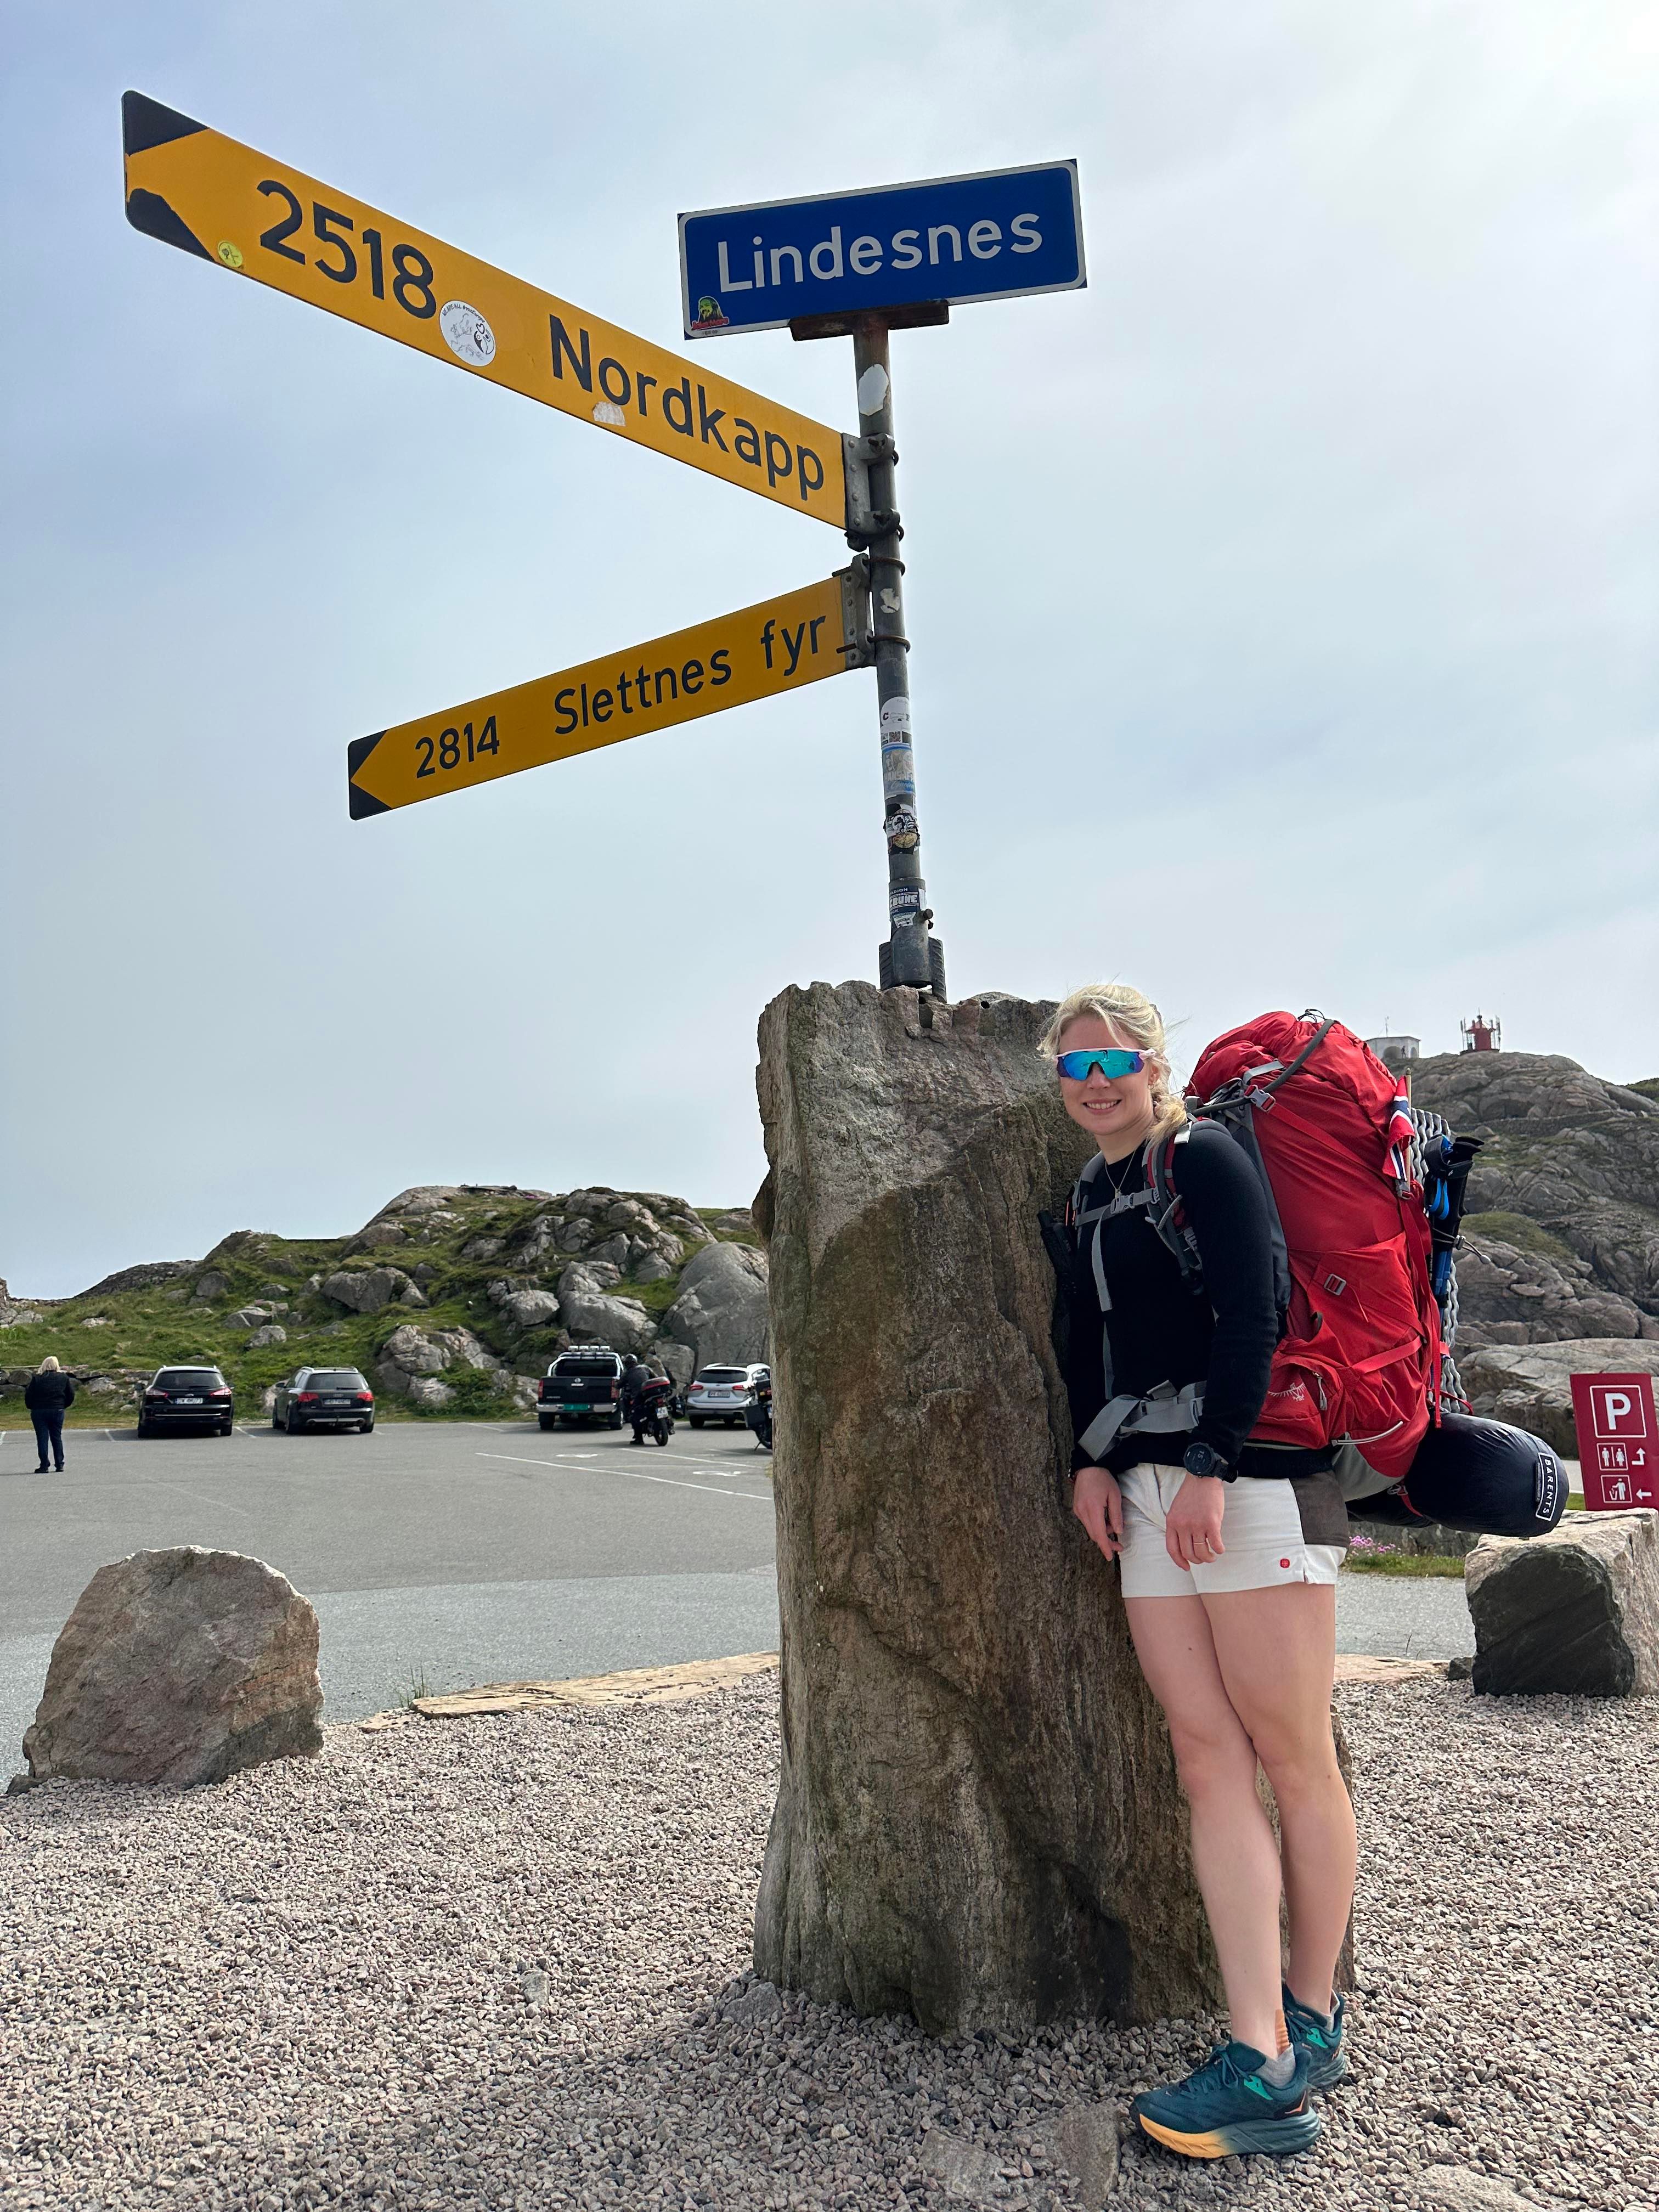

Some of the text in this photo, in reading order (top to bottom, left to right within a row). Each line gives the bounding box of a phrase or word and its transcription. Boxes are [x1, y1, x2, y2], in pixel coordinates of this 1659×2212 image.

[718, 213, 1043, 292] Lindesnes
[256, 179, 824, 501] 2518 Nordkapp
[415, 615, 826, 779] 2814 Slettnes fyr
[1605, 1392, 1632, 1430] P
[1543, 1459, 1554, 1514] BARENTS
